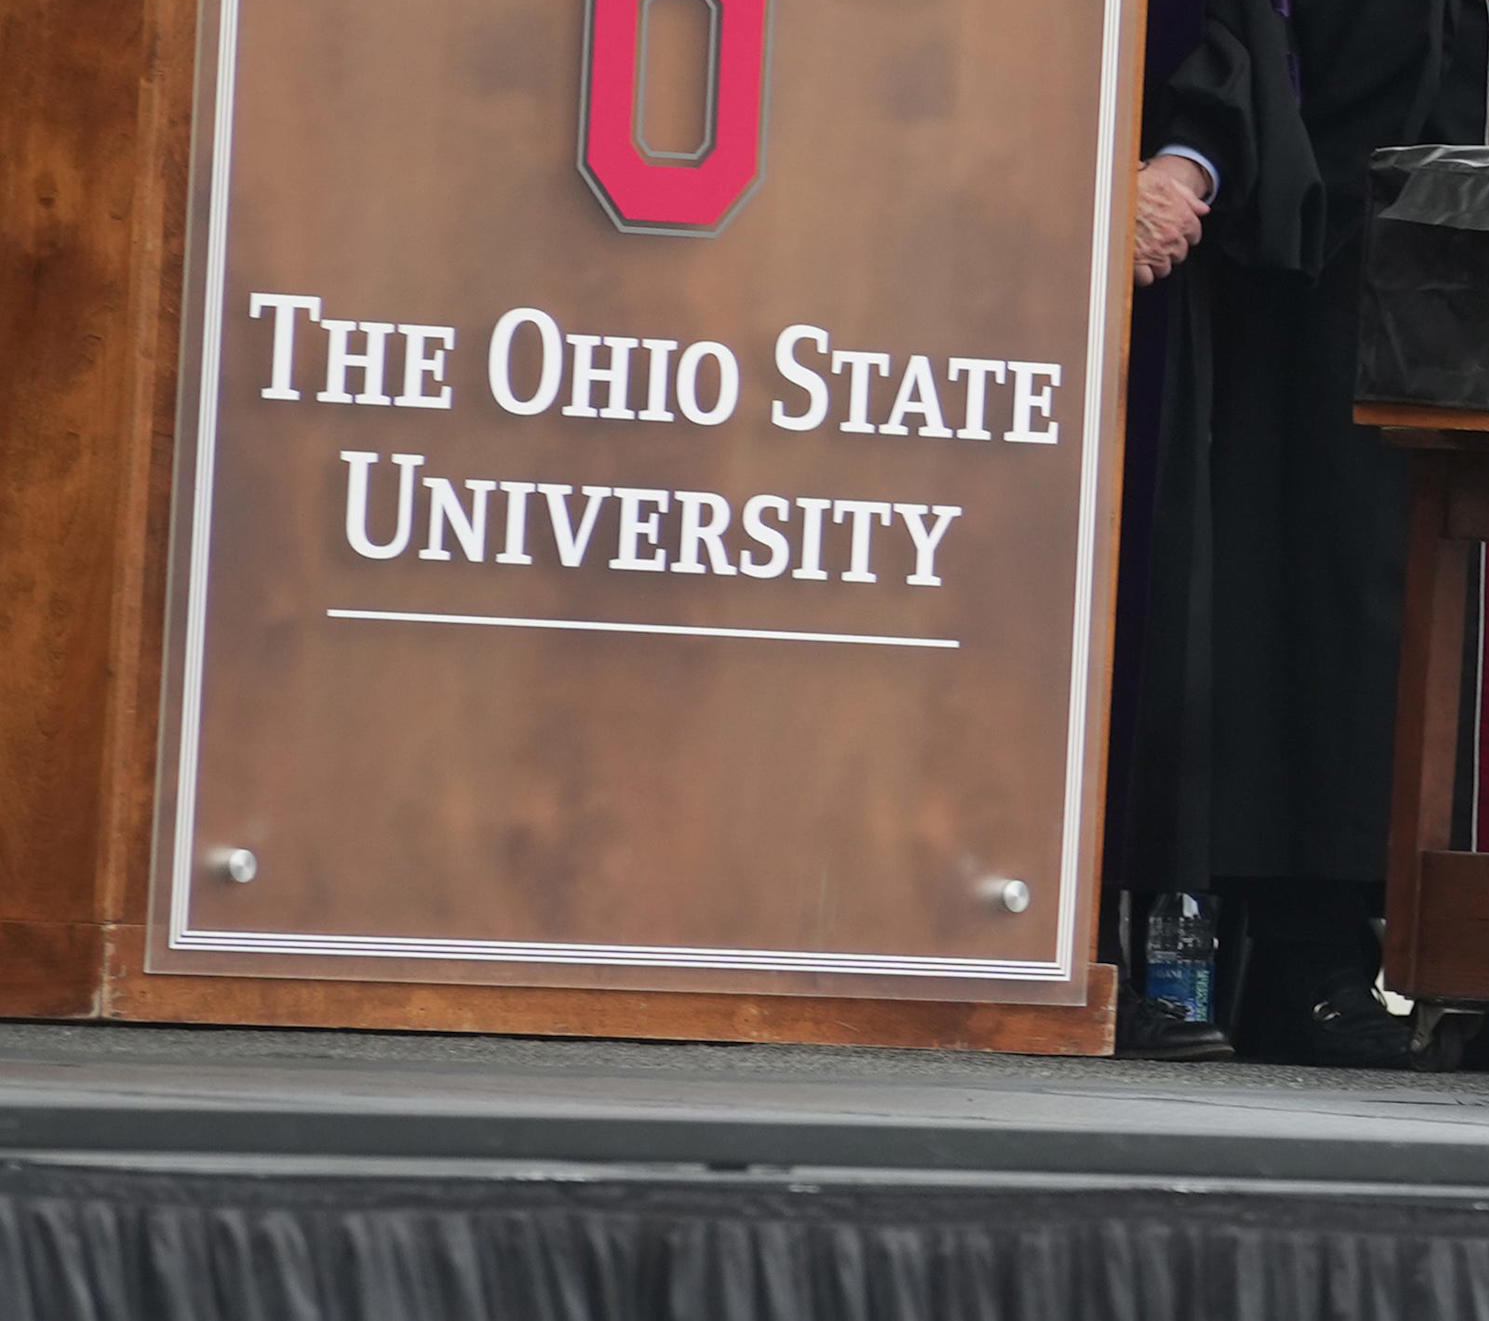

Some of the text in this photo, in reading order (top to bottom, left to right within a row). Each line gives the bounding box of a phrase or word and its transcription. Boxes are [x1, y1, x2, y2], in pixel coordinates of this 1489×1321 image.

[249, 292, 1063, 445] THE OHIO STATE
[339, 450, 963, 587] UNIVERSITY
